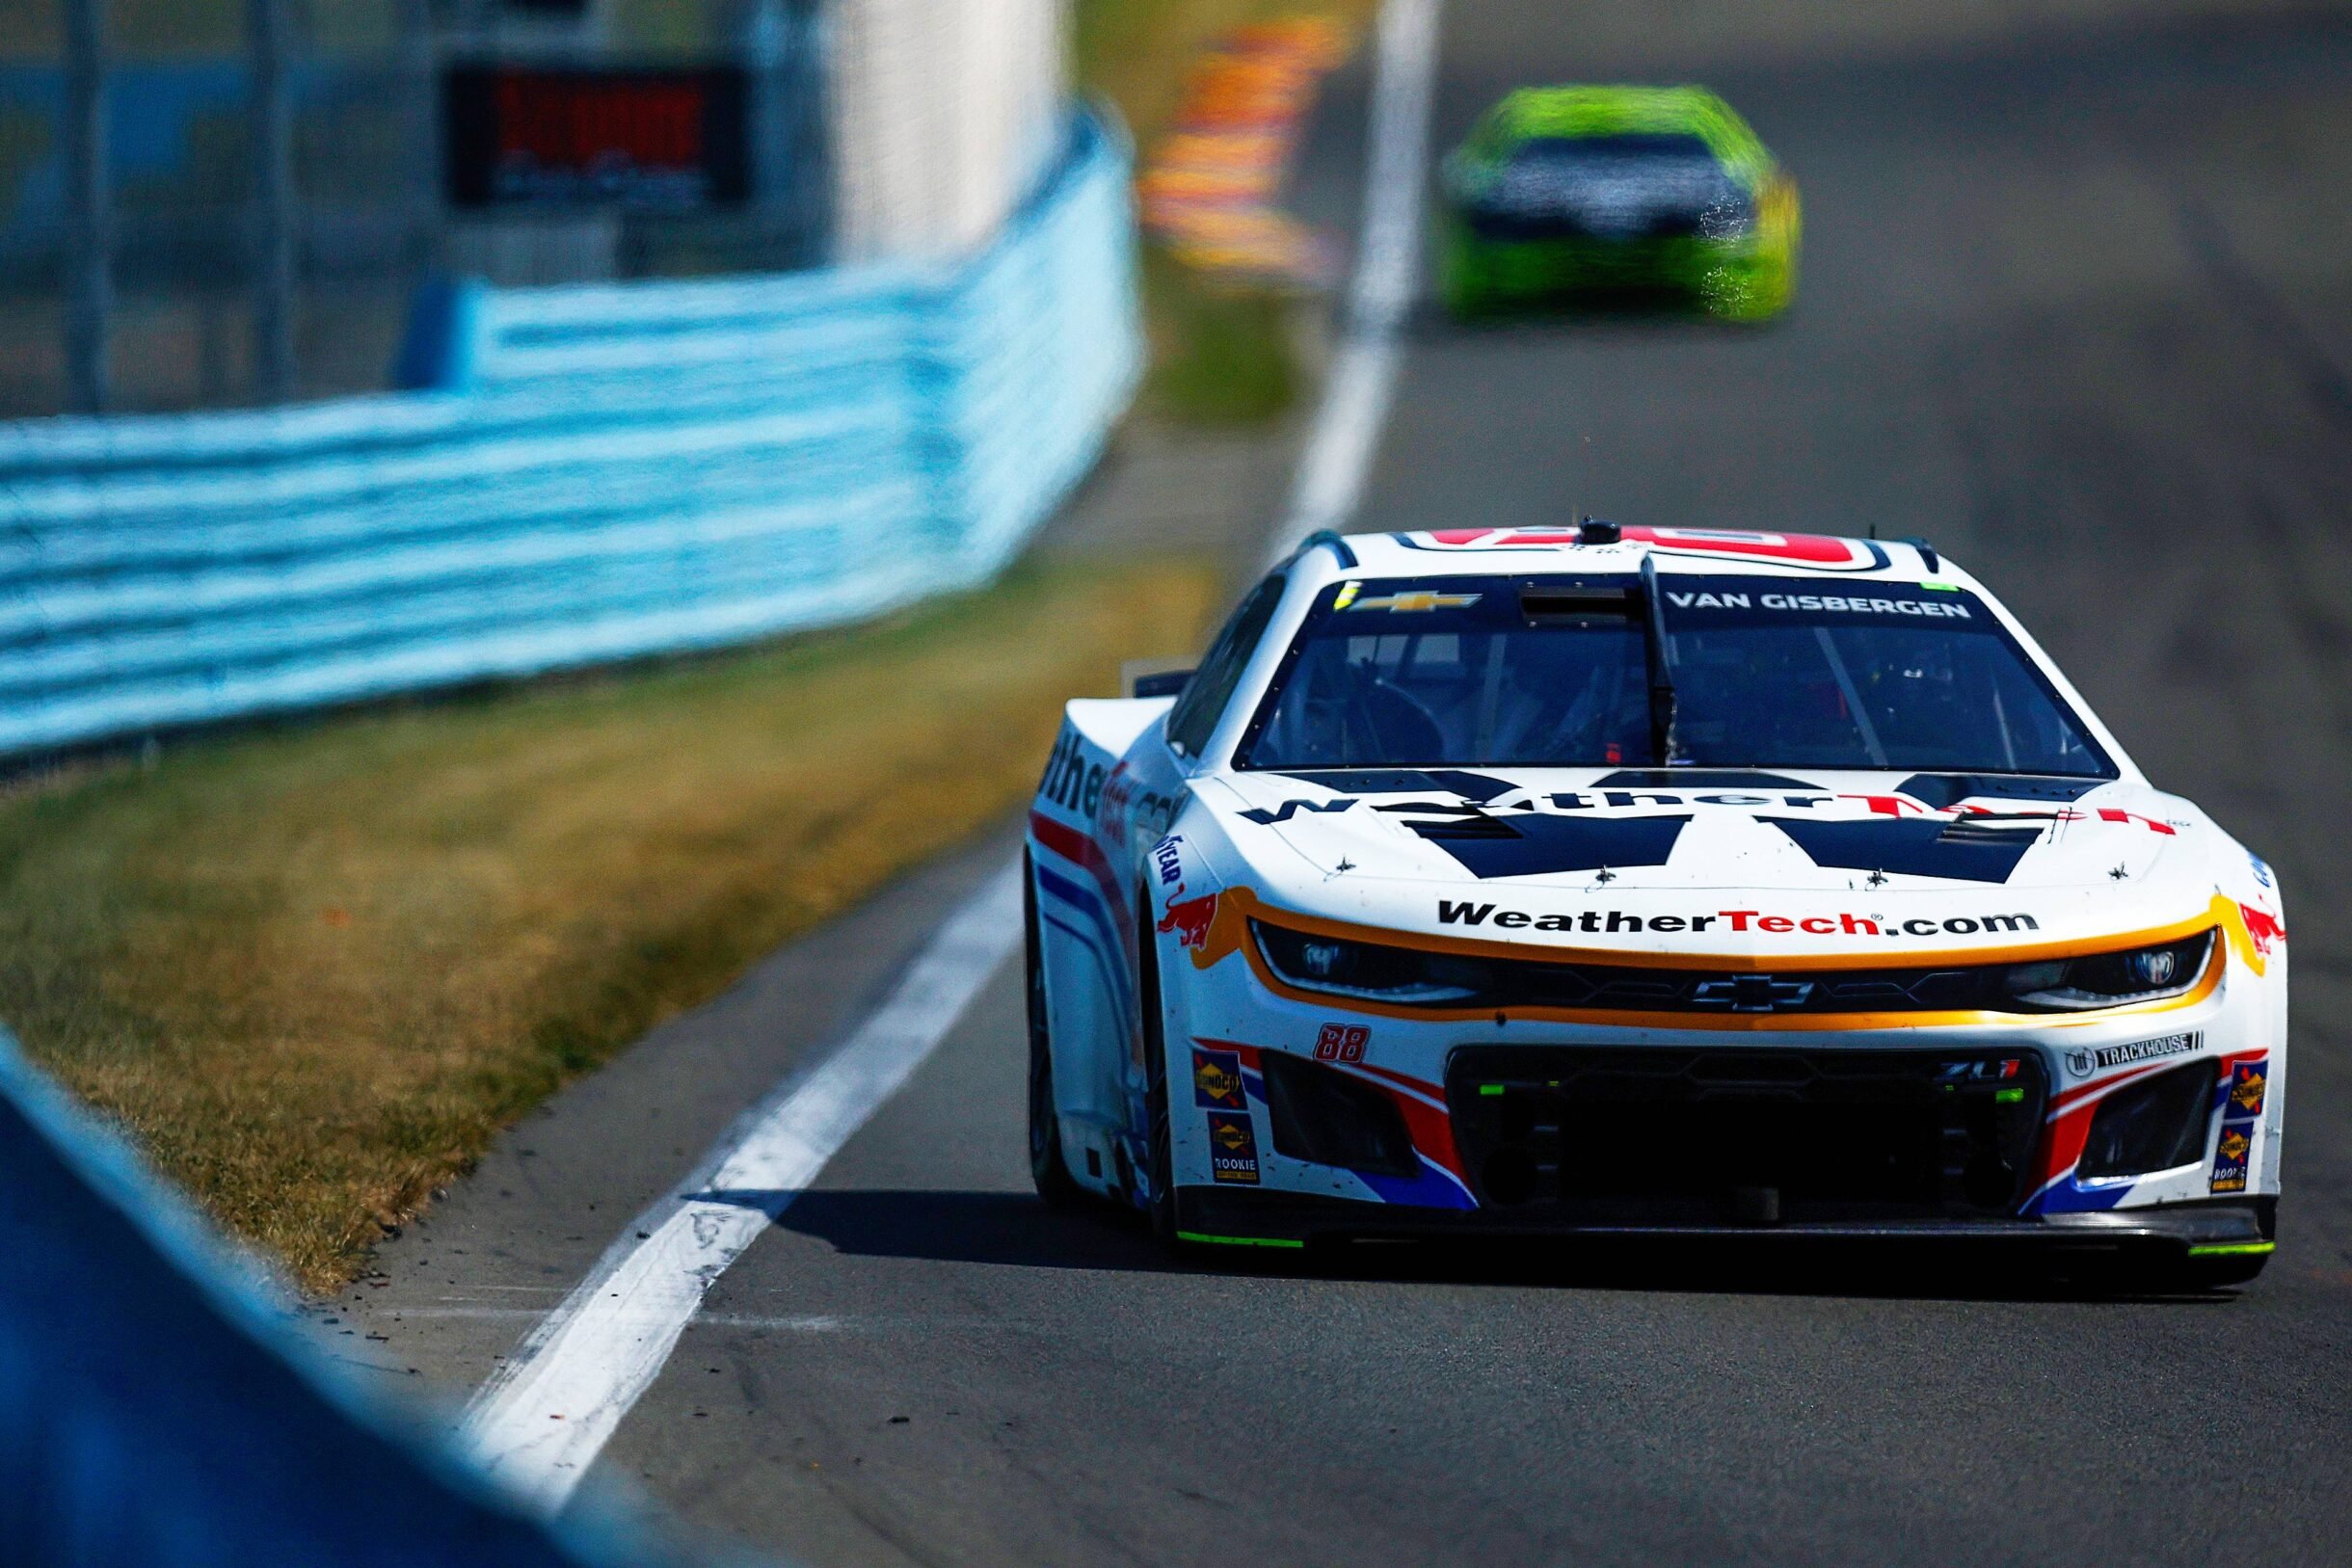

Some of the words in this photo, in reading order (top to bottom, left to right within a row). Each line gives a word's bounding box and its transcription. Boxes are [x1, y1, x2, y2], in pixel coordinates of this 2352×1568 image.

[1666, 591, 1751, 608] VAN
[1760, 593, 1972, 619] GISBERGEN
[1312, 1023, 1372, 1064] 88
[2102, 1033, 2190, 1066] TRACKHOUSE
